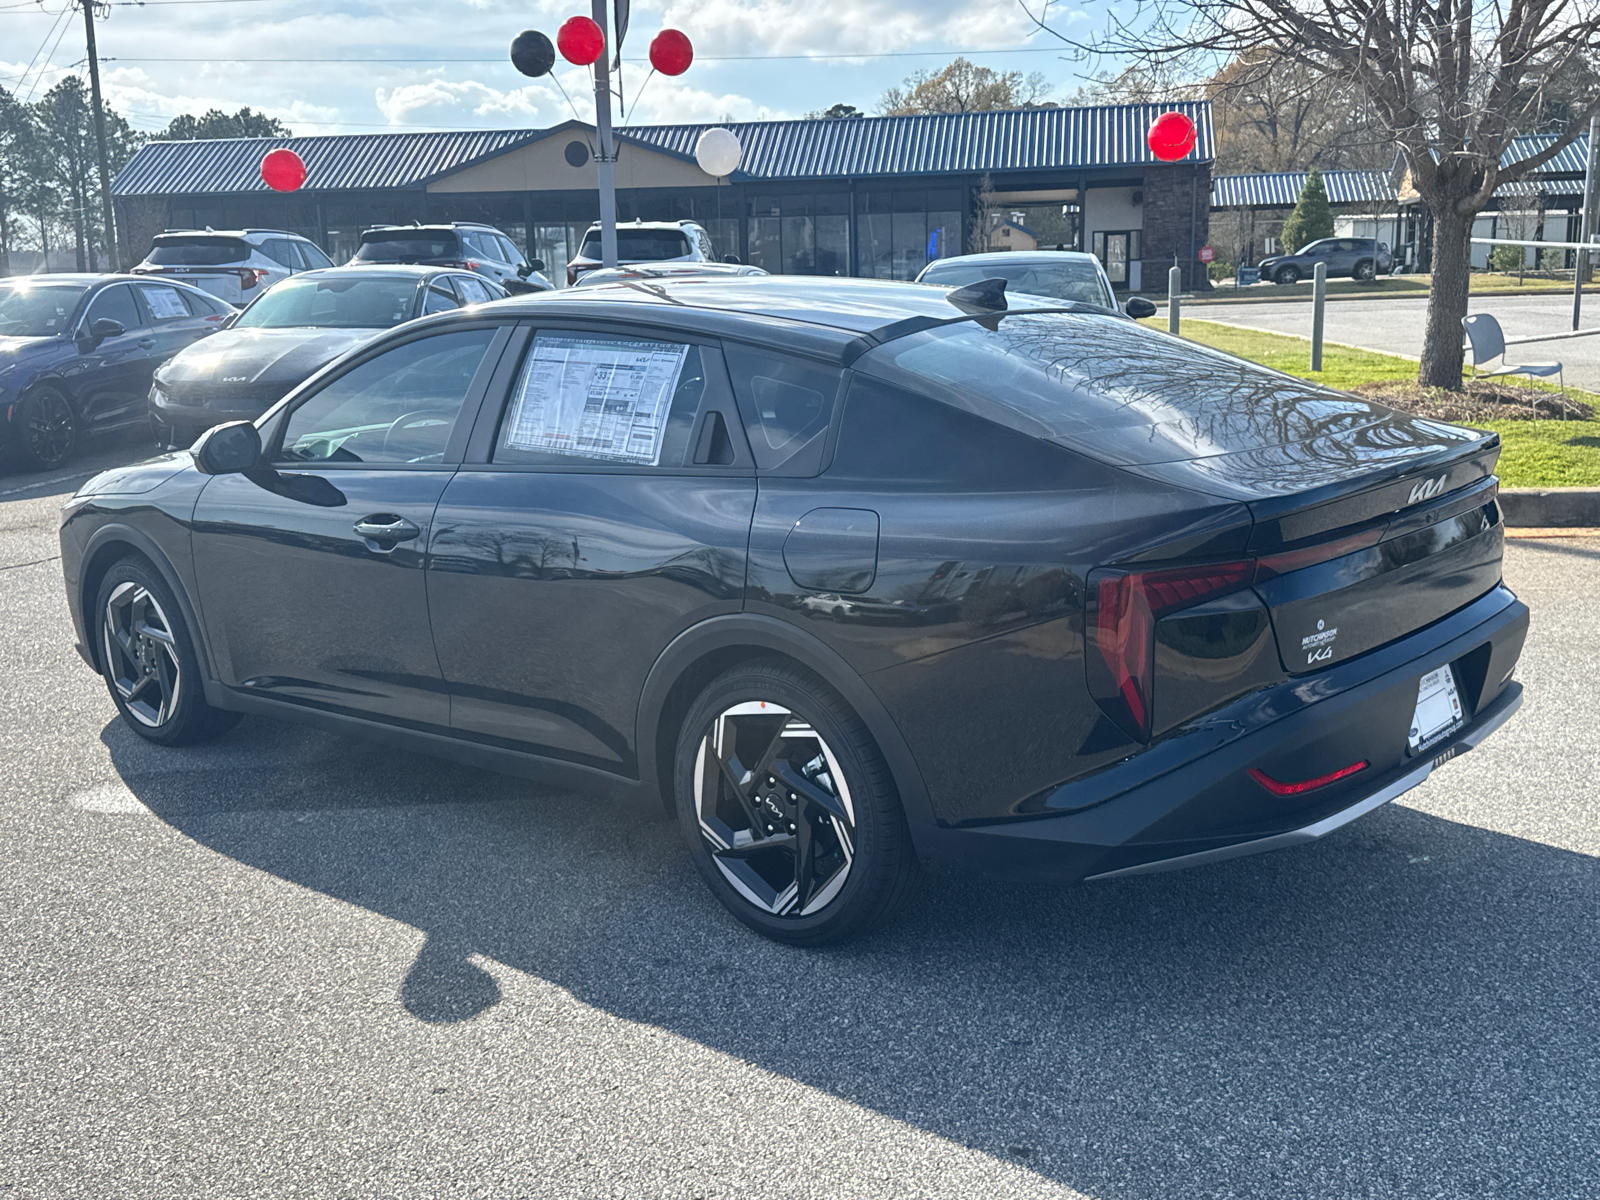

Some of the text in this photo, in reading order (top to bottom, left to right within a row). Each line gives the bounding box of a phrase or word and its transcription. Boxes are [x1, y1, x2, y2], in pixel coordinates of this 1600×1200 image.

[1407, 474, 1447, 504] KIA
[1307, 646, 1333, 664] K4
[765, 797, 784, 818] KIA
[857, 784, 873, 855] KUMHO
